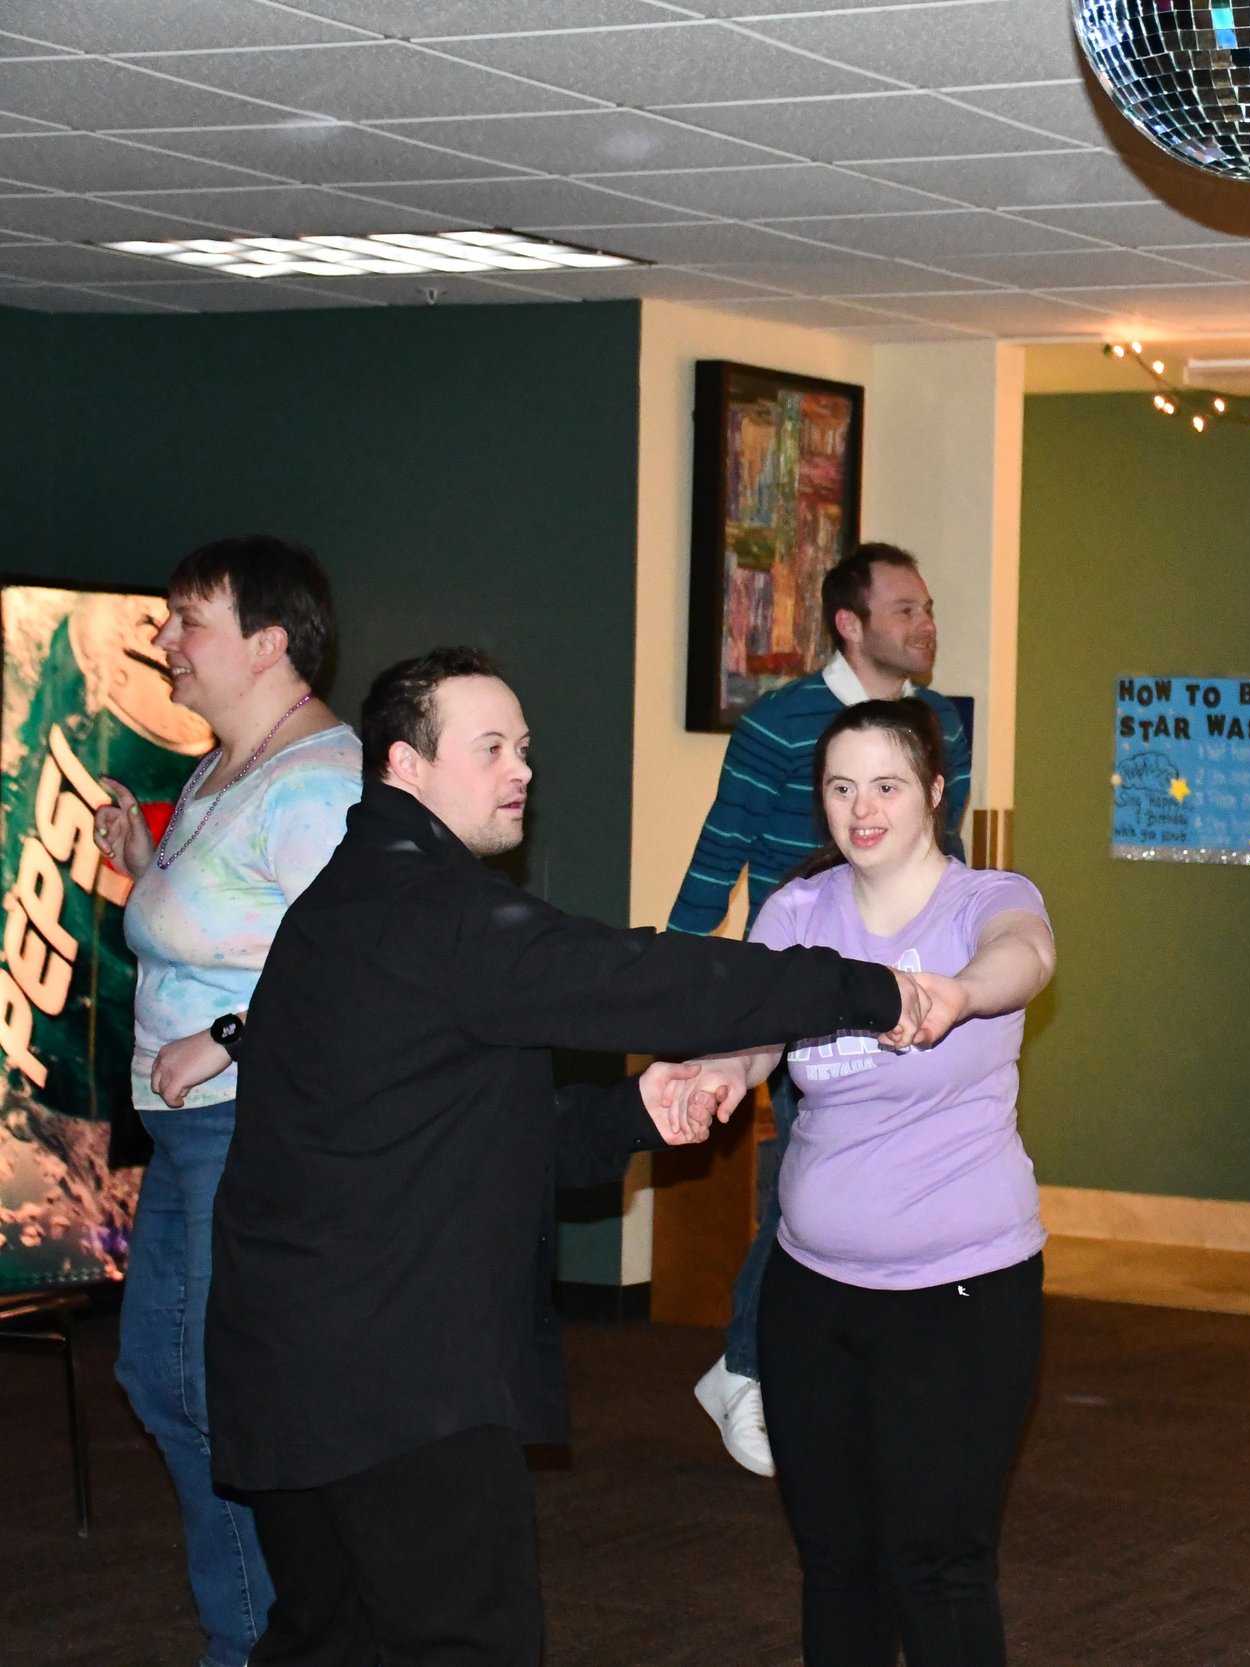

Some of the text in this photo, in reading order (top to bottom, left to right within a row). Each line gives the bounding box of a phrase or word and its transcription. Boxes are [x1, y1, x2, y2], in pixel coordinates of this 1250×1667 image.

[1119, 680, 1171, 706] HOW
[1186, 684, 1221, 708] TO
[1120, 716, 1190, 742] STAR
[0, 723, 112, 1089] PEPSI
